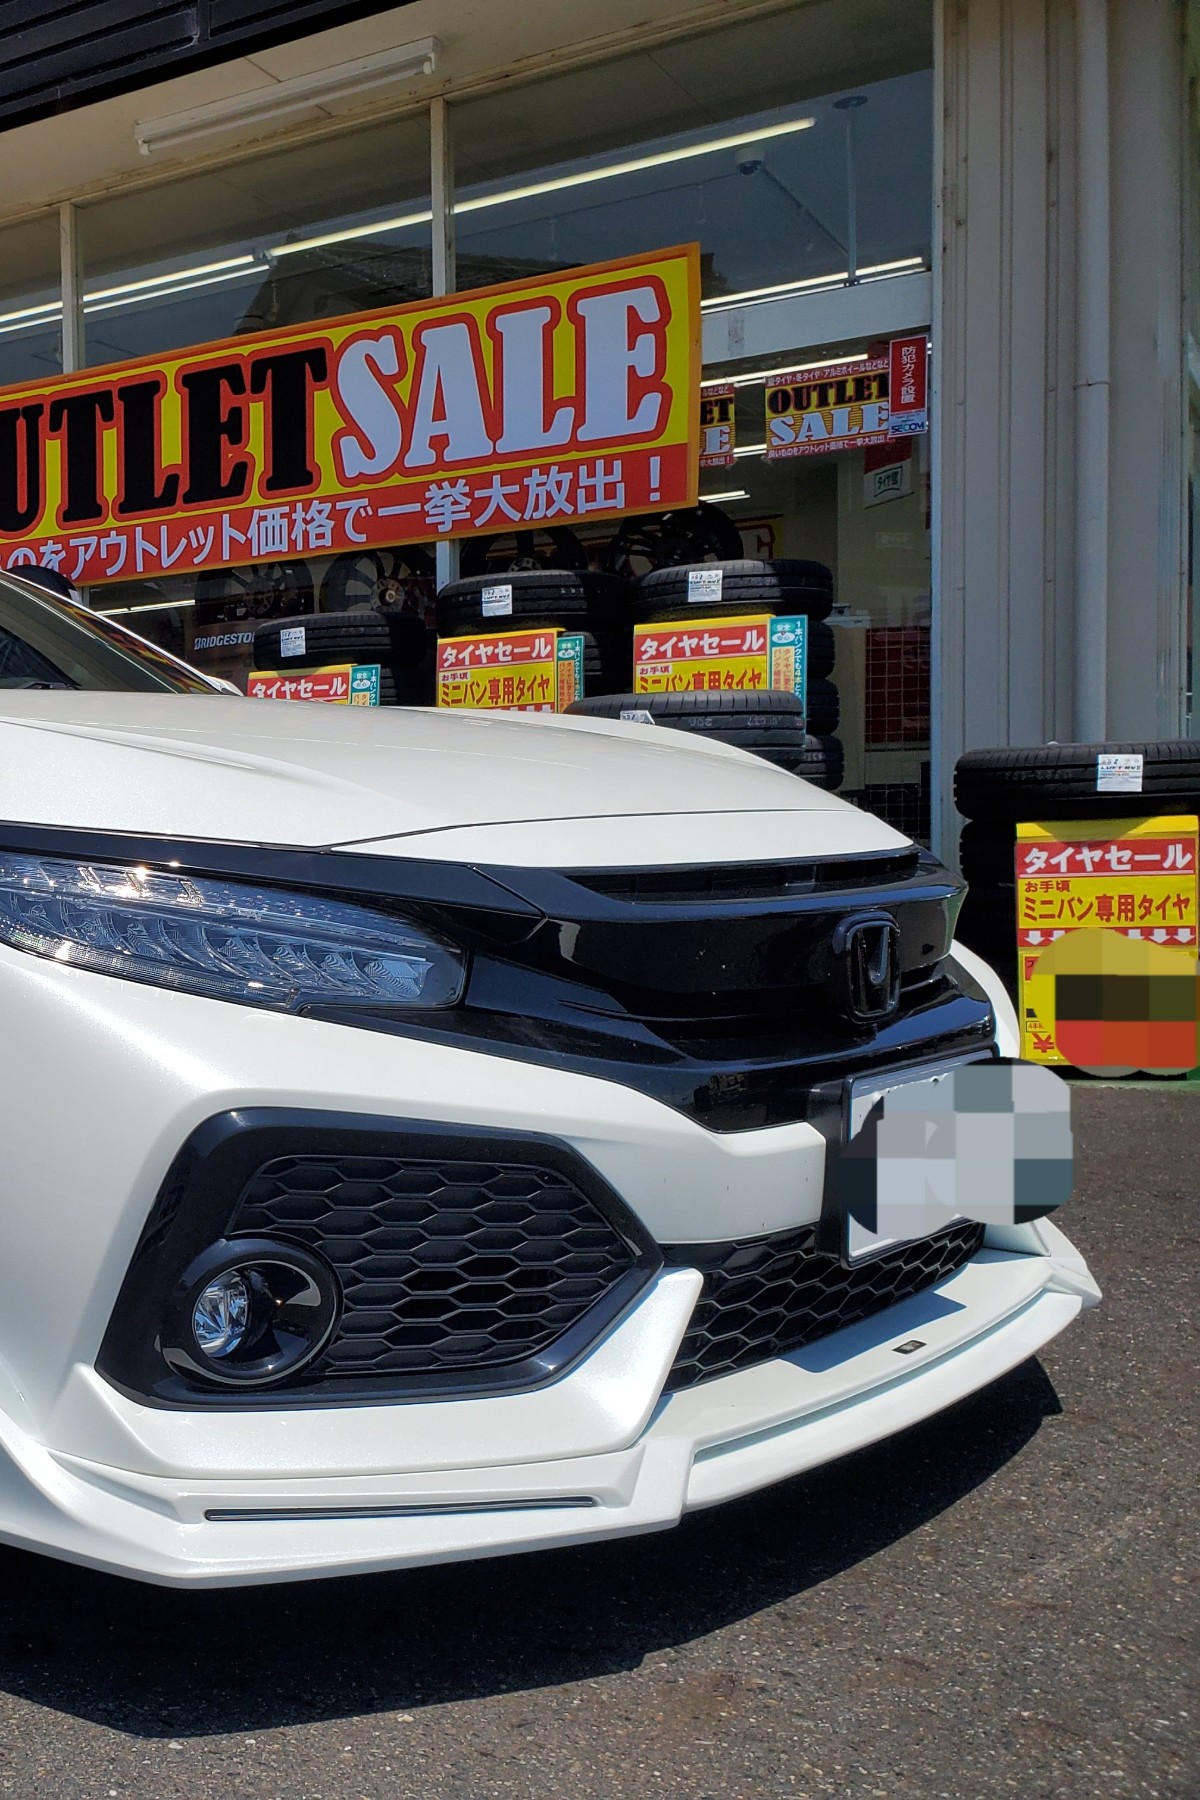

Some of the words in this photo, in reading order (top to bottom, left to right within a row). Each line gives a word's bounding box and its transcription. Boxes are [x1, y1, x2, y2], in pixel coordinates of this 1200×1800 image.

[336, 285, 664, 478] SALE
[901, 345, 917, 405] 防犯カメラ設置
[769, 401, 889, 447] SALE
[891, 421, 925, 434] SECOM
[442, 637, 552, 668] タイヤセール
[640, 629, 765, 661] タイヤセール
[441, 671, 469, 682] お手頃
[639, 664, 671, 675] お手頃
[251, 676, 347, 700] タイヤセール
[441, 673, 550, 706] ミニバン専用タイヤ
[1023, 843, 1192, 874] タイヤセール
[1023, 879, 1072, 894] お手頃
[1022, 893, 1191, 923] ミニバン専用タイヤ
